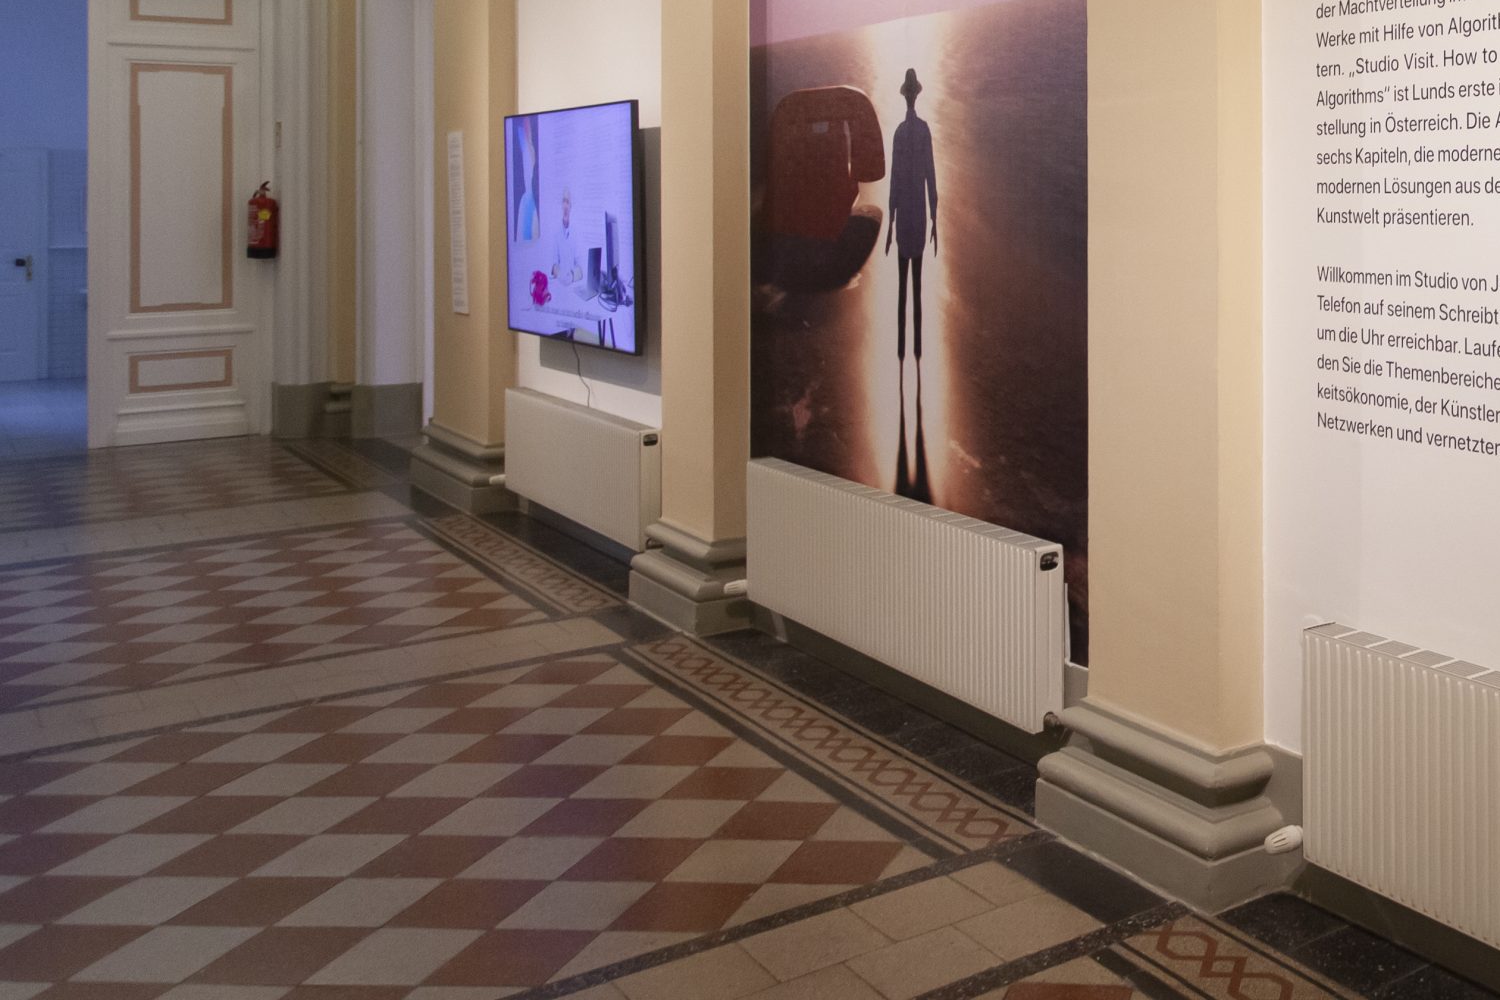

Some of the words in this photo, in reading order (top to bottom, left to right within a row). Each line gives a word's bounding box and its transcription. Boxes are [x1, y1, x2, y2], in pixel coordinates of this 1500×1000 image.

[1315, 2, 1337, 20] der
[1315, 29, 1357, 49] Werke
[1358, 25, 1380, 45] mit
[1382, 21, 1415, 43] Hilfe
[1417, 22, 1445, 39] von
[1393, 84, 1410, 103] ist
[1412, 80, 1456, 102] Lunds
[1457, 79, 1496, 99] erste
[1315, 118, 1367, 139] stellung
[1369, 116, 1382, 134] in
[1384, 111, 1463, 134] Österreich.
[1465, 111, 1492, 131] Die
[1316, 147, 1353, 166] sechs
[1354, 145, 1412, 168] Kapiteln,
[1413, 145, 1435, 164] die
[1316, 206, 1381, 225] Kunstwelt
[1382, 207, 1475, 229] präsentieren.
[1316, 294, 1362, 315] Telefon
[1363, 298, 1385, 317] auf
[1386, 300, 1436, 321] seinem
[1316, 381, 1413, 415] keitsökonomie,
[1414, 395, 1439, 415] der
[1316, 410, 1394, 440] Netzwerken
[1396, 426, 1423, 445] und
